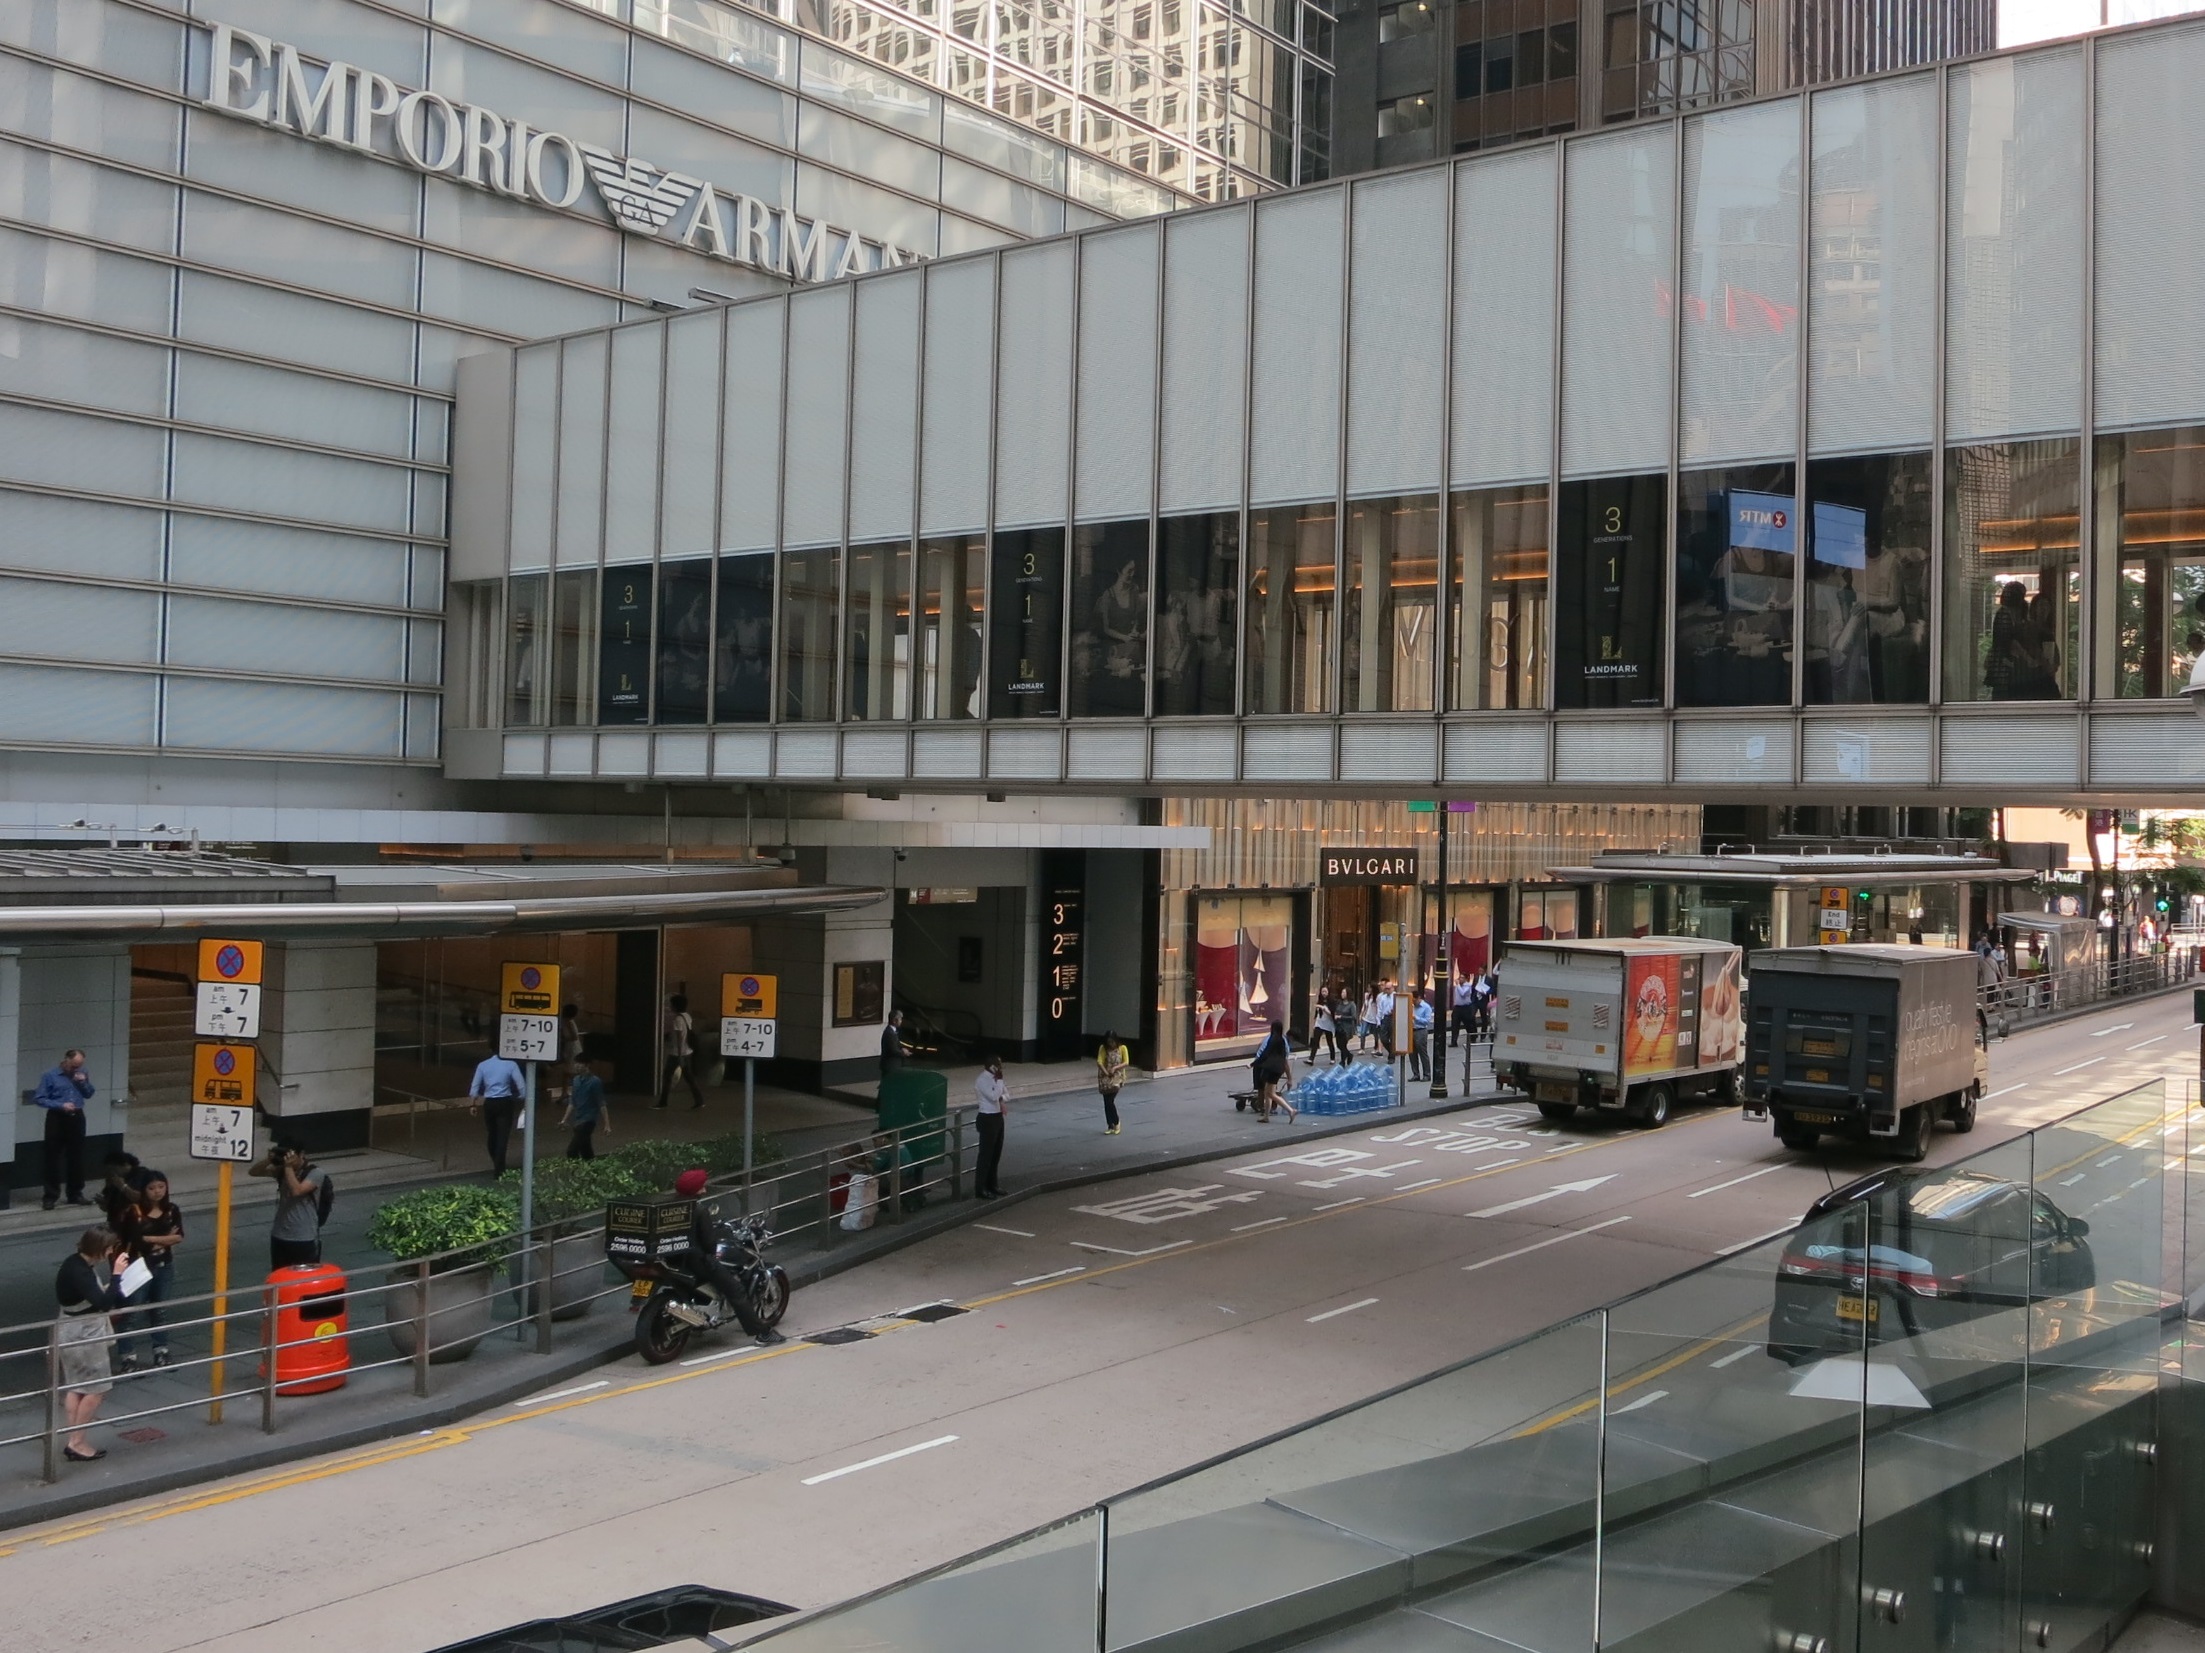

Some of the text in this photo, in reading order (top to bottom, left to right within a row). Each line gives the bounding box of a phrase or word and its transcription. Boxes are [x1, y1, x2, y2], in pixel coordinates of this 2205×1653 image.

[202, 20, 585, 208] EMPORIO
[676, 181, 936, 283] ARMA
[1604, 506, 1621, 533] 3
[1023, 553, 1035, 575] 3
[1607, 557, 1615, 583] 1
[624, 585, 633, 604] 3
[1025, 594, 1031, 616] 1
[1584, 665, 1638, 674] LANDMARK
[1008, 683, 1045, 691] LANDMARK
[1328, 858, 1414, 875] BVLGARI
[2053, 870, 2084, 885] PIAGET
[1053, 903, 1064, 925] 3
[1053, 933, 1063, 955] 2
[1053, 965, 1060, 987] 1
[213, 985, 225, 993] am
[238, 988, 249, 1006] 7
[209, 994, 227, 1004] 上午
[1051, 997, 1063, 1019] 0
[208, 1022, 226, 1033] 下午
[236, 1016, 247, 1034] 7
[521, 1019, 553, 1033] 7-10
[743, 1023, 772, 1035] 7-10
[520, 1040, 545, 1053] 5-7
[741, 1041, 764, 1052] 4-7
[202, 1116, 220, 1127] 上午
[230, 1110, 240, 1127] 7
[194, 1133, 227, 1145] midnight
[1370, 1128, 1532, 1154] STOP
[230, 1139, 248, 1157] 12
[1224, 1148, 1423, 1189] 巴士
[1069, 1183, 1266, 1225] 站
[628, 1244, 647, 1254] 0000
[673, 1241, 689, 1251] 0000
